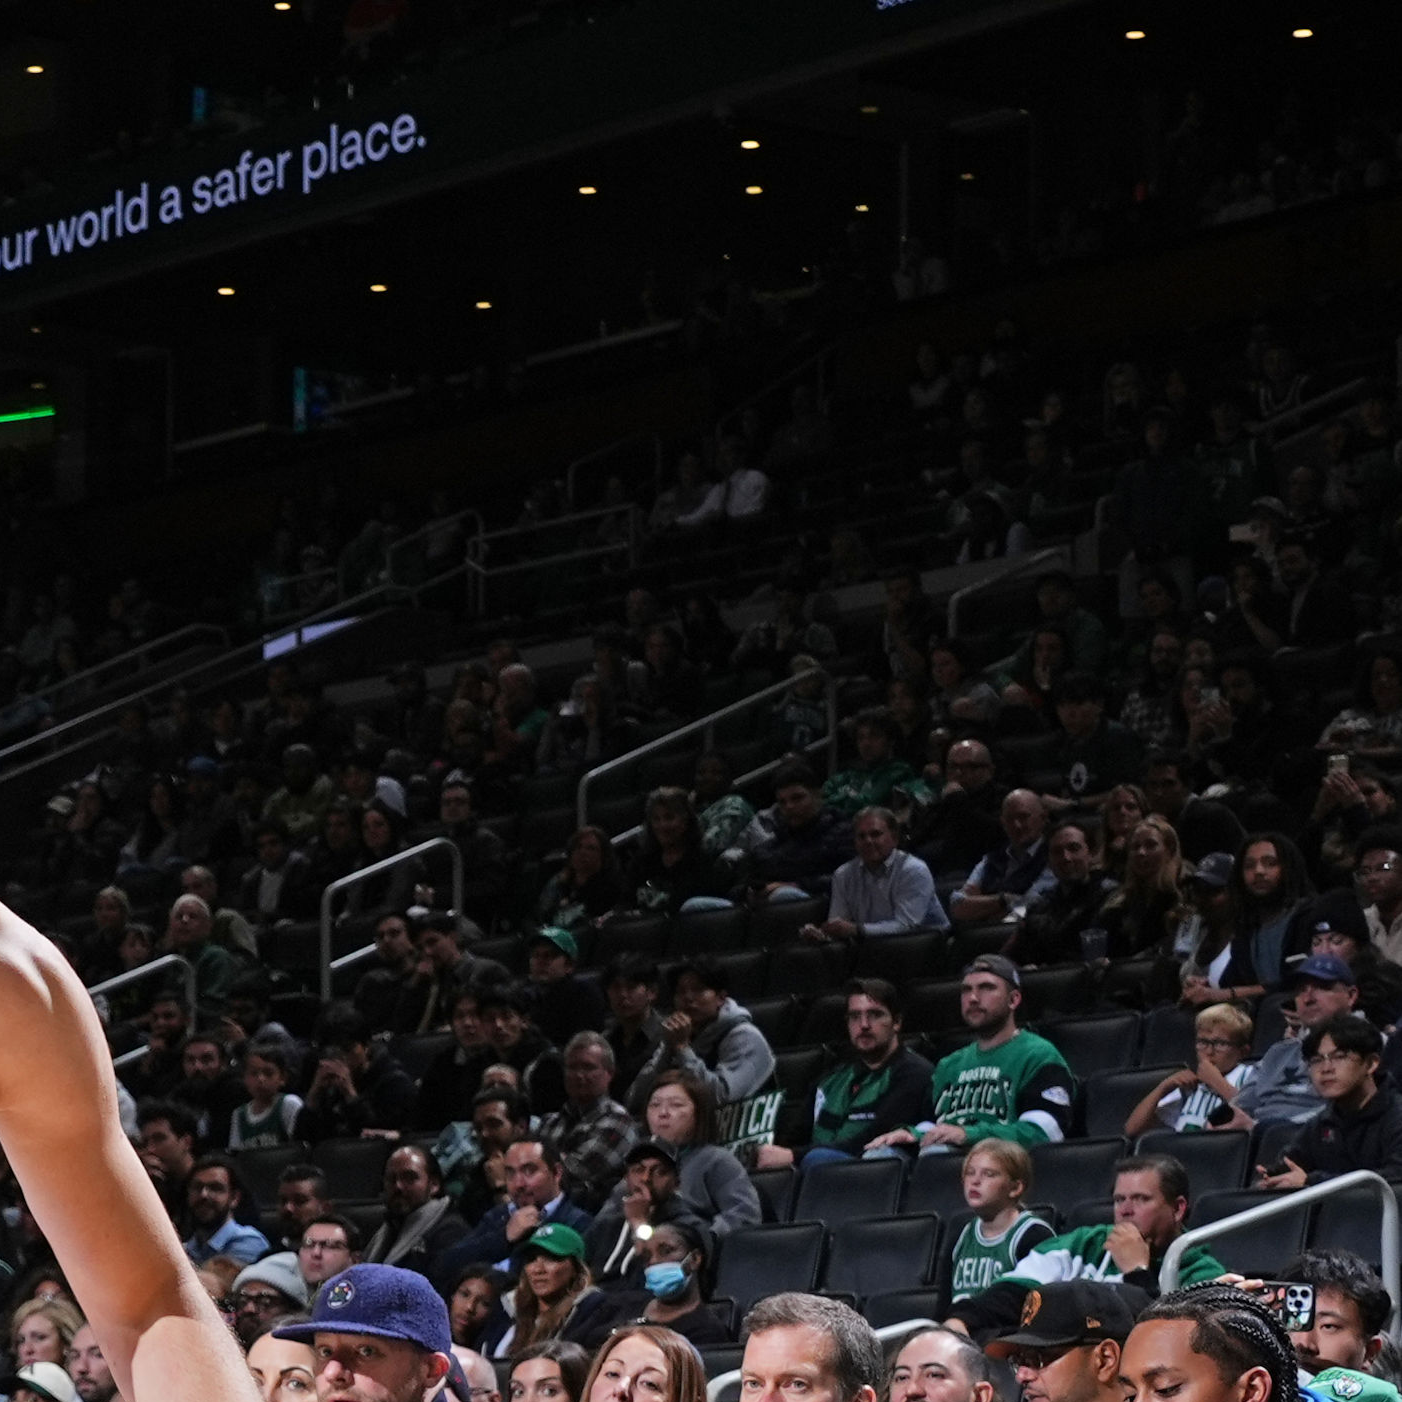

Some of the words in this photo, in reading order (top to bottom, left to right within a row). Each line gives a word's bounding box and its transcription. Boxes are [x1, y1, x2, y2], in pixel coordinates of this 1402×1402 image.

[46, 181, 150, 257] world
[159, 184, 183, 225] a
[192, 149, 292, 214] safer
[303, 112, 427, 194] place.
[958, 1066, 1000, 1083] BOSTON
